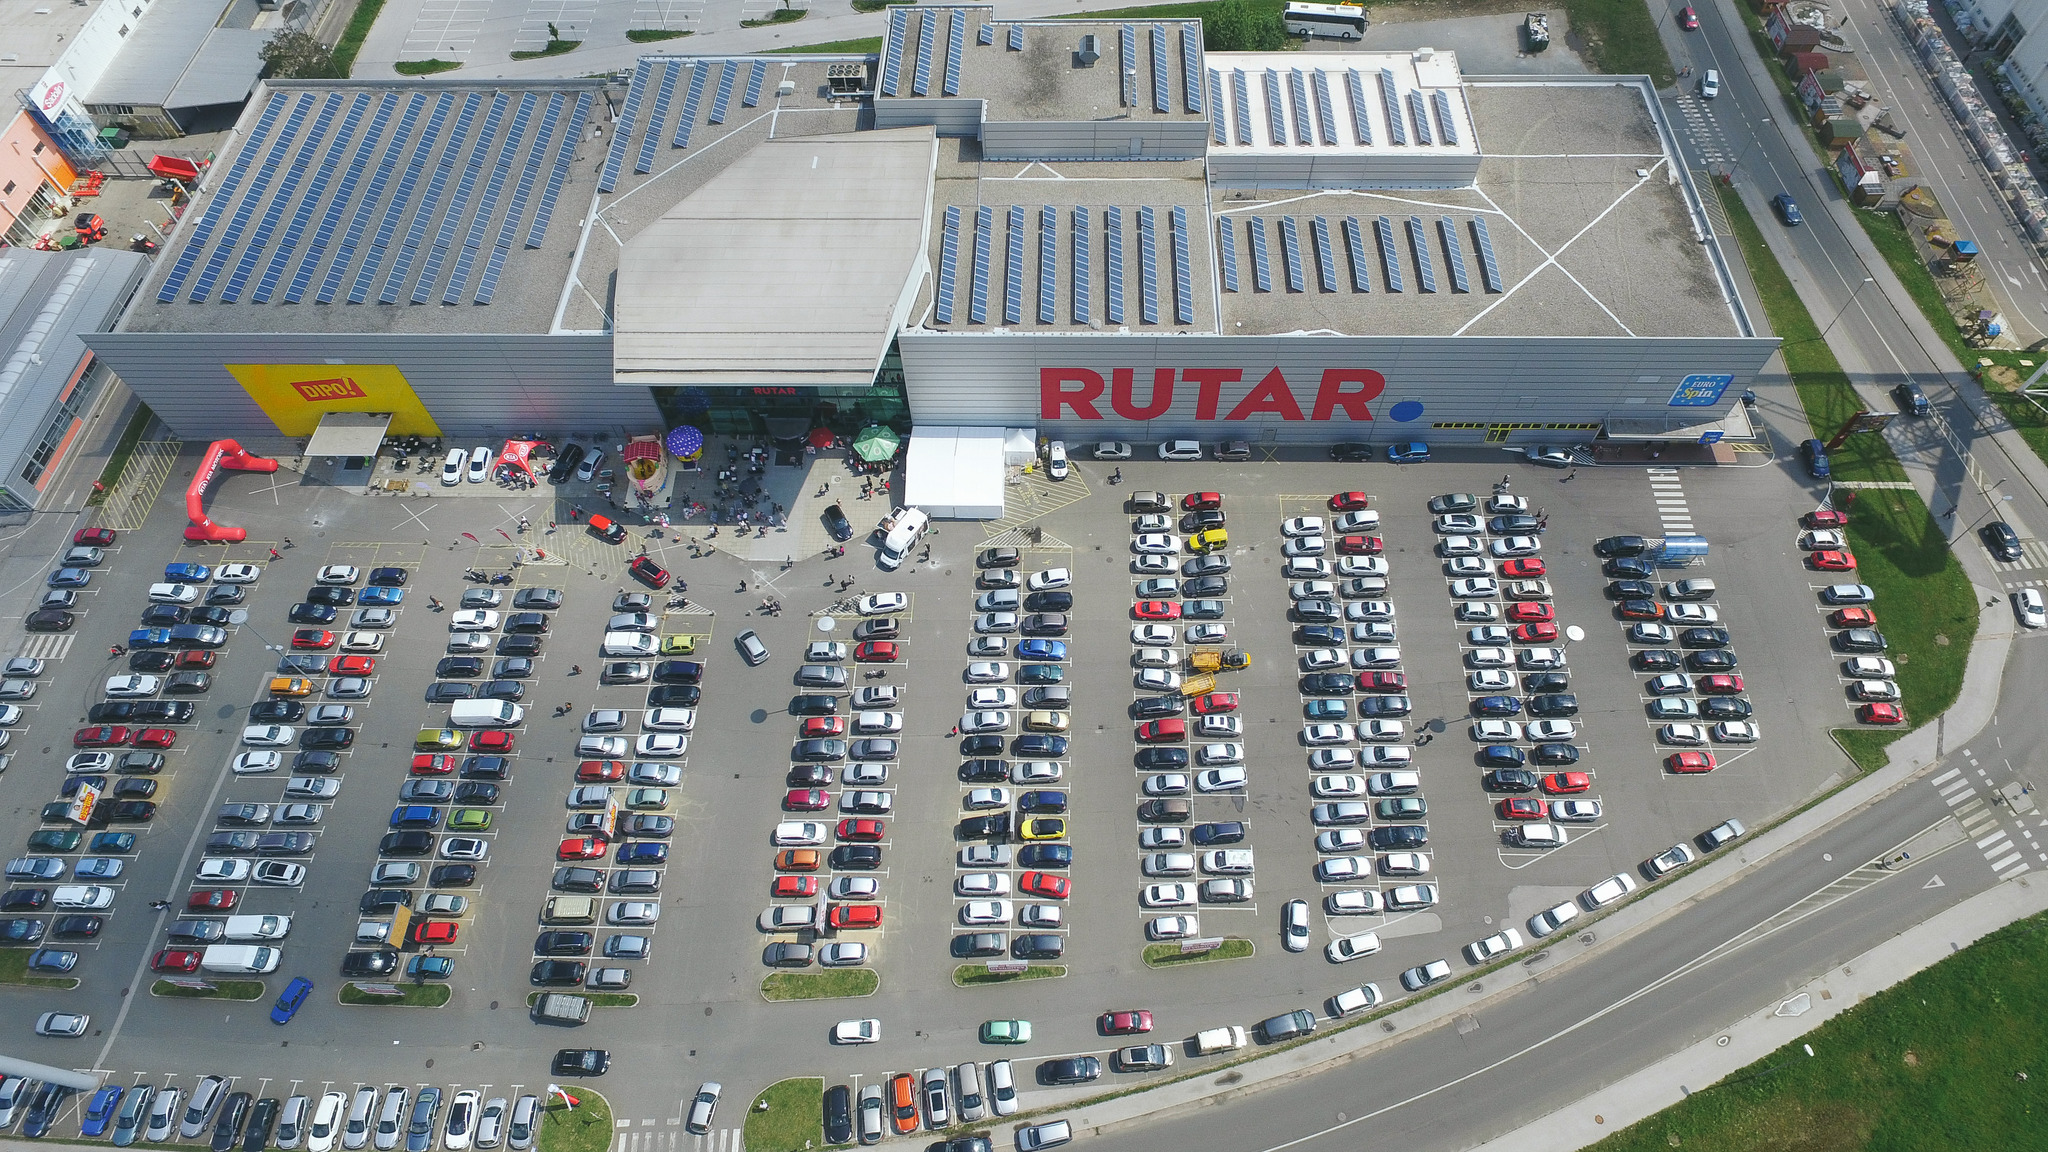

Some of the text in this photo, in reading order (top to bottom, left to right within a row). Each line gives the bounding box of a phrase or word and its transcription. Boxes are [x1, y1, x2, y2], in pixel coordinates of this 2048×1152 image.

[45, 85, 63, 107] Sadolin
[300, 377, 356, 398] DIPO!
[753, 387, 796, 395] RUTAR
[1040, 365, 1386, 421] RUTAR
[1681, 388, 1713, 399] Spin
[206, 470, 214, 480] KIA
